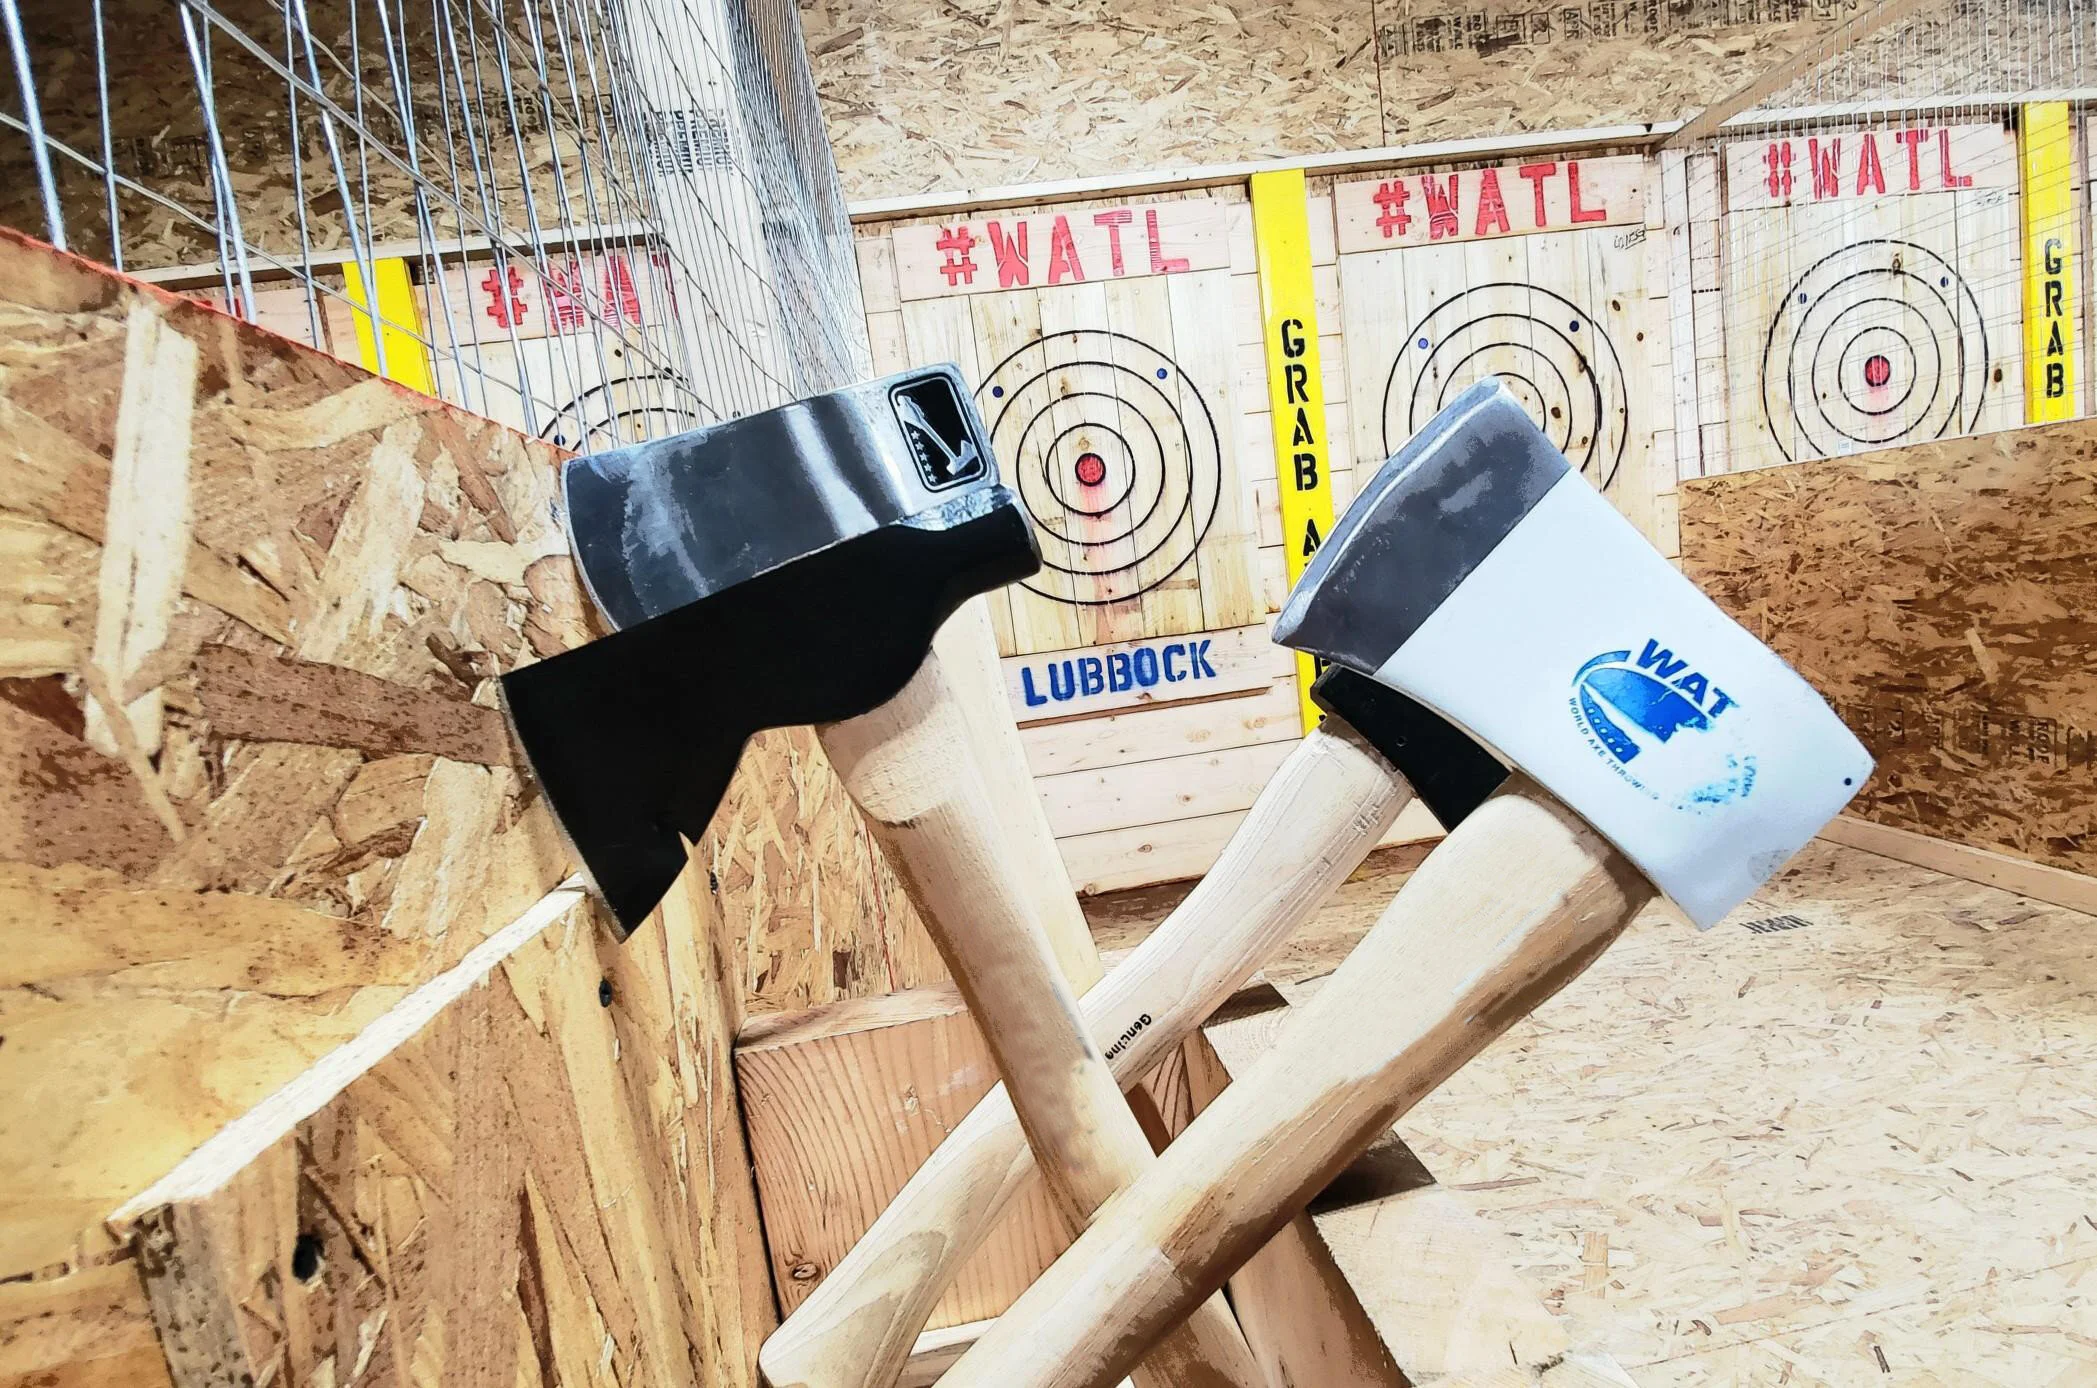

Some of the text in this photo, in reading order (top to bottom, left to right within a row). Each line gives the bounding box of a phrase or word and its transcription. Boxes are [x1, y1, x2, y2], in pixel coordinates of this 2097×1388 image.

[1372, 161, 1607, 240] #WATL
[1763, 128, 1973, 199] #WATL
[935, 209, 1190, 288] #WATL
[2044, 238, 2065, 398] GRAB
[1281, 319, 1318, 491] GRAB
[1022, 640, 1217, 707] LUBBOCK
[1568, 697, 1589, 736] WORLD
[1587, 738, 1607, 758] AXE
[1104, 1013, 1152, 1060] Genuine
